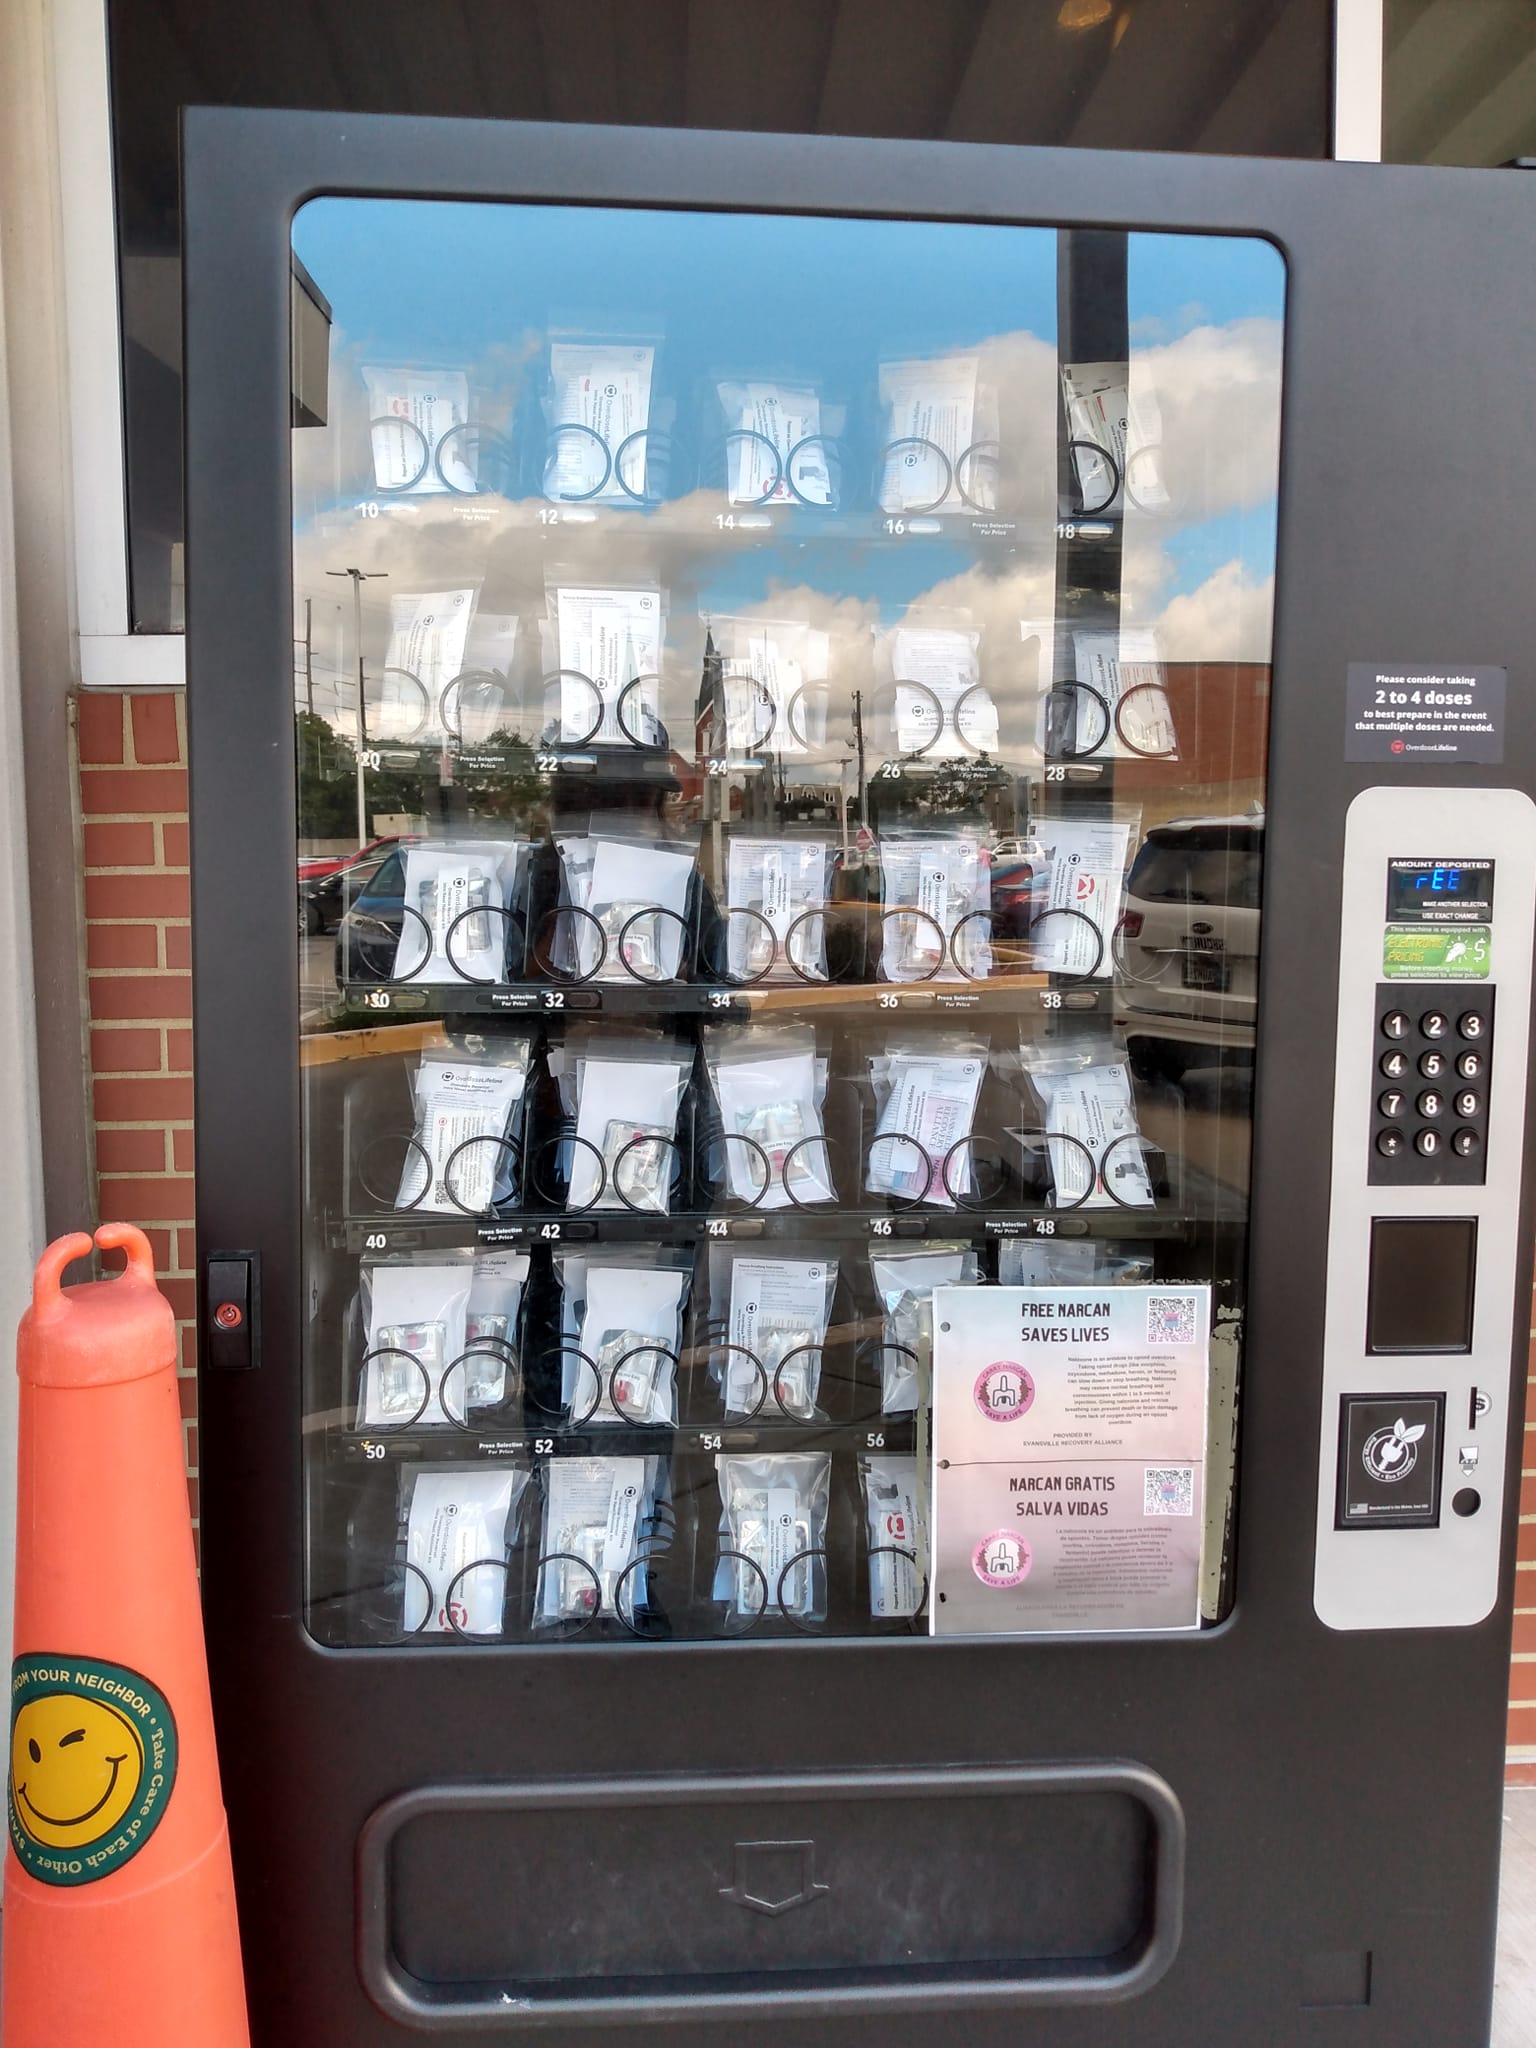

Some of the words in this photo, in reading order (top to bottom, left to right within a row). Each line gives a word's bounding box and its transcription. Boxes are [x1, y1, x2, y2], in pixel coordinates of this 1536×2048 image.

[358, 502, 379, 518] 10
[538, 509, 558, 524] 12
[716, 514, 735, 529] 14
[886, 520, 904, 534] 16
[1057, 524, 1075, 539] 18
[1376, 675, 1405, 684] Please
[1406, 675, 1445, 684] consider
[1447, 676, 1476, 686] taking
[1375, 690, 1386, 704] 2
[1389, 691, 1407, 704] to
[1410, 690, 1421, 704] 4
[1425, 690, 1472, 705] doses
[1375, 710, 1395, 718] best
[1396, 711, 1432, 720] prepare
[1444, 711, 1459, 719] the
[1376, 722, 1414, 732] multiple
[1415, 723, 1441, 731] doses
[538, 756, 558, 771] 22
[709, 760, 728, 775] 24
[882, 763, 900, 778] 26
[1046, 766, 1065, 781] 28
[545, 993, 564, 1008] 32
[712, 993, 730, 1007] 34
[880, 993, 898, 1008] 36
[1043, 994, 1061, 1008] 38
[1391, 1016, 1401, 1035] 1
[1430, 1016, 1441, 1035] 2
[1467, 1017, 1480, 1035] 3
[1388, 1056, 1402, 1074] 4
[1427, 1056, 1440, 1074] 5
[1464, 1056, 1477, 1075] 6
[1388, 1095, 1400, 1114] 7
[1425, 1095, 1437, 1114] 8
[1463, 1094, 1476, 1114] 9
[1424, 1133, 1436, 1152] 0
[541, 1224, 560, 1238] 42
[709, 1222, 728, 1236] 44
[873, 1221, 892, 1235] 46
[1036, 1220, 1055, 1235] 48
[365, 1234, 386, 1248] 40
[1021, 1303, 1054, 1318] FREE
[1058, 1303, 1111, 1317] NARCAN
[1021, 1327, 1068, 1342] SAVES
[1071, 1327, 1110, 1342] LIVES
[985, 1410, 1000, 1419] SAVE
[1009, 1409, 1022, 1418] LIFE
[535, 1439, 553, 1454] 52
[704, 1435, 722, 1450] 54
[867, 1433, 885, 1447] 56
[366, 1444, 386, 1459] 50
[1010, 1477, 1061, 1491] NARCAN
[1065, 1477, 1115, 1491] GRATIS
[1016, 1502, 1062, 1516] SALVA
[1068, 1502, 1108, 1516] VIDAS
[30, 1669, 70, 1682] YOUR
[74, 1672, 152, 1718] NEIGHBOR
[152, 1728, 166, 1770] Take
[140, 1774, 164, 1816] Care
[126, 1818, 141, 1839] of
[86, 1835, 130, 1867] Each
[36, 1856, 82, 1874] Other
